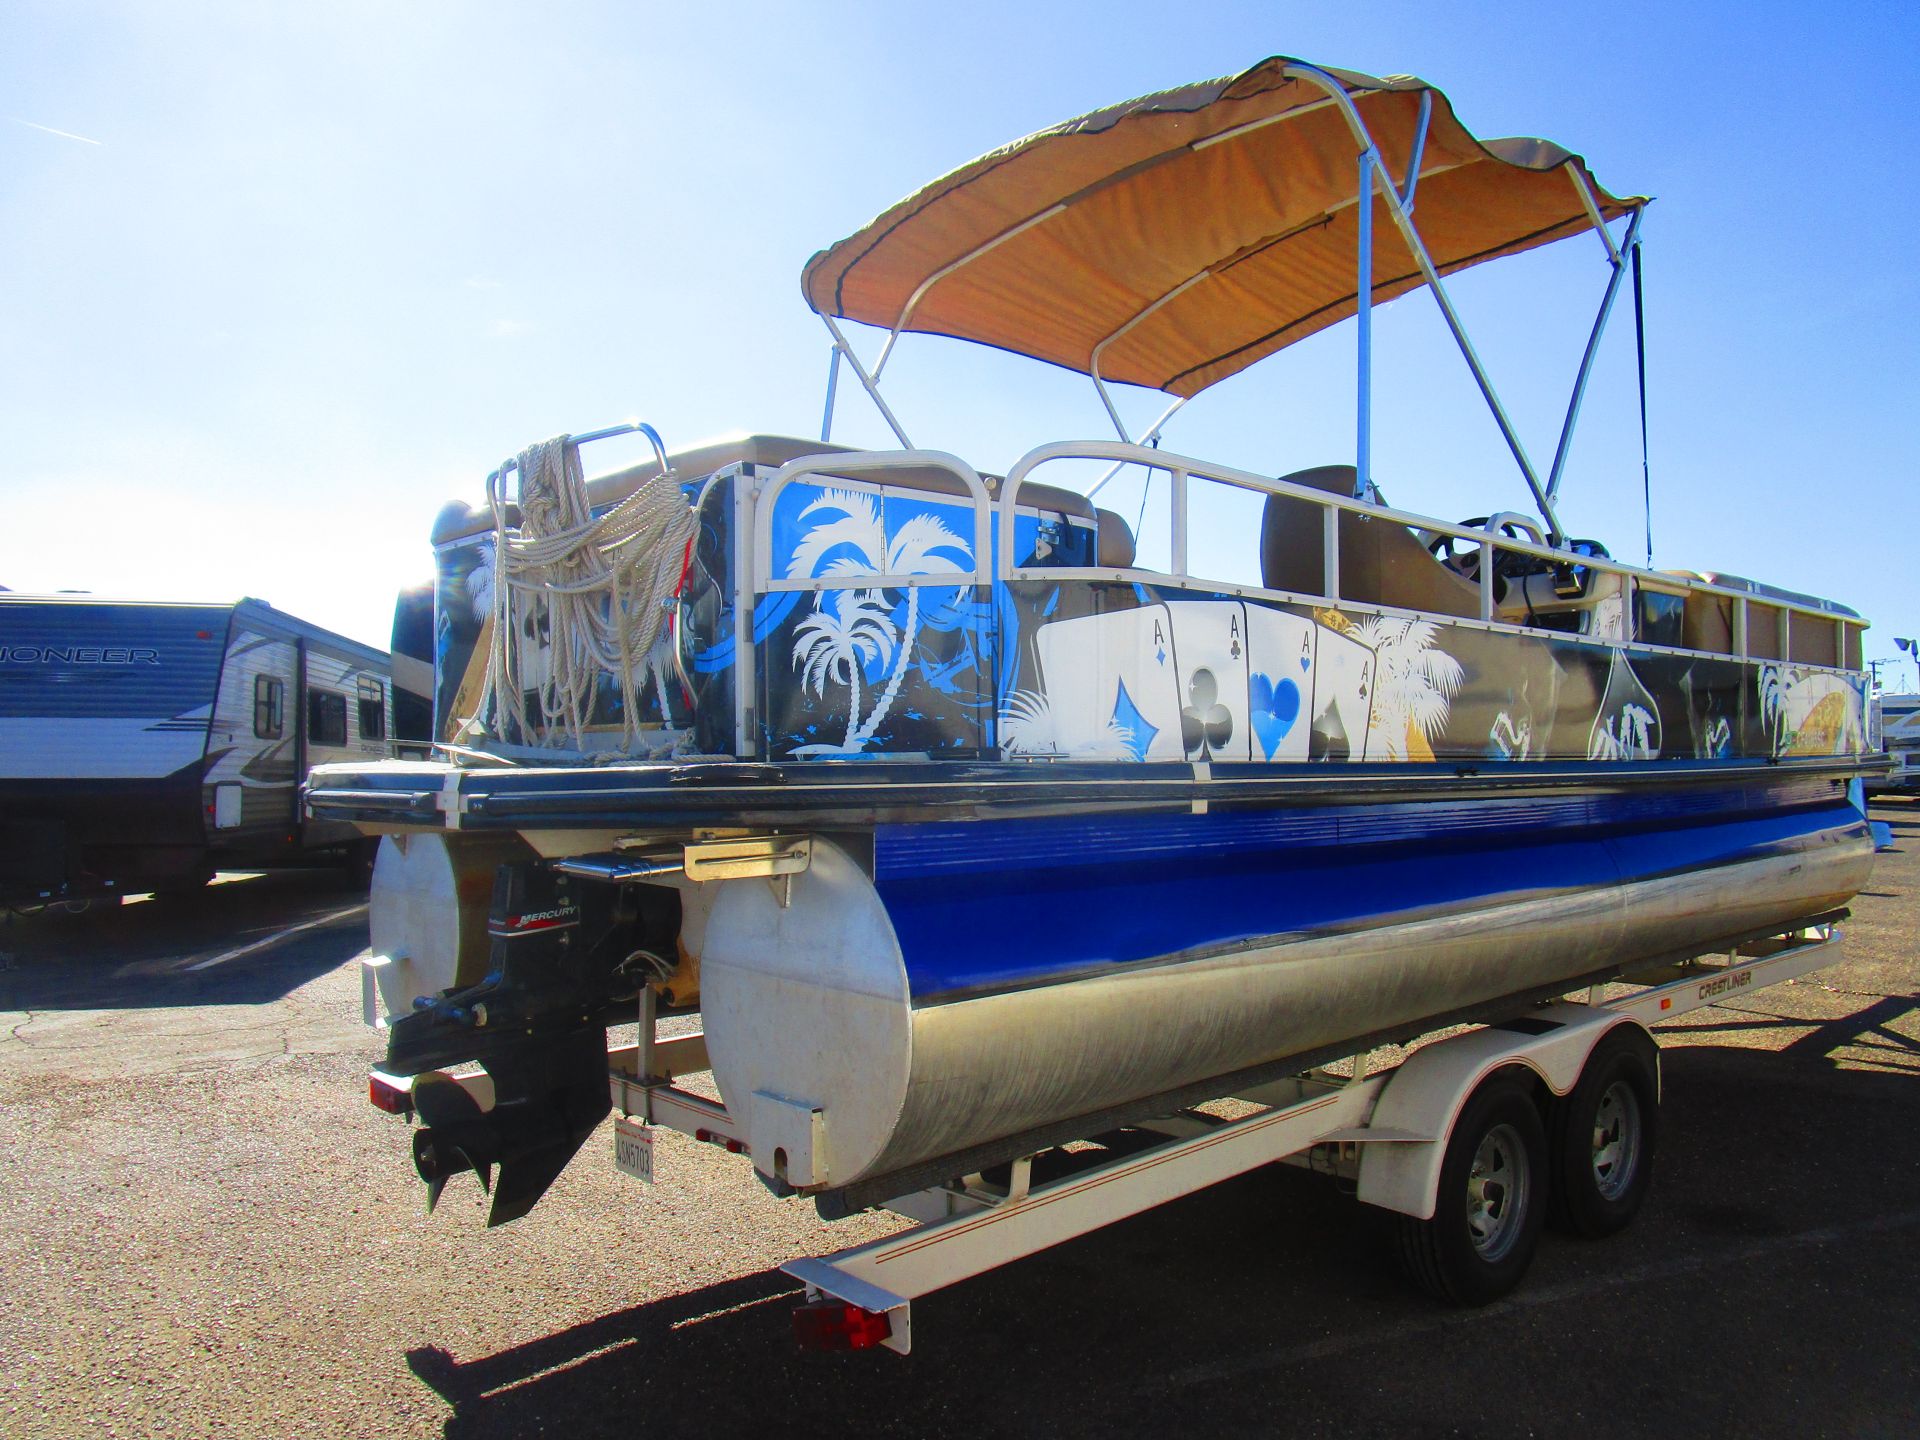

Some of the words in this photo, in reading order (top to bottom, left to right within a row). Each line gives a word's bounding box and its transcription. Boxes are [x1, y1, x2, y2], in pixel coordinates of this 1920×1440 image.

[1154, 618, 1165, 645] A
[1230, 613, 1240, 639] A
[1302, 630, 1310, 654] A
[1360, 660, 1369, 683] A
[518, 906, 577, 925] MERCURY
[1698, 971, 1752, 1001] CRESTLINER
